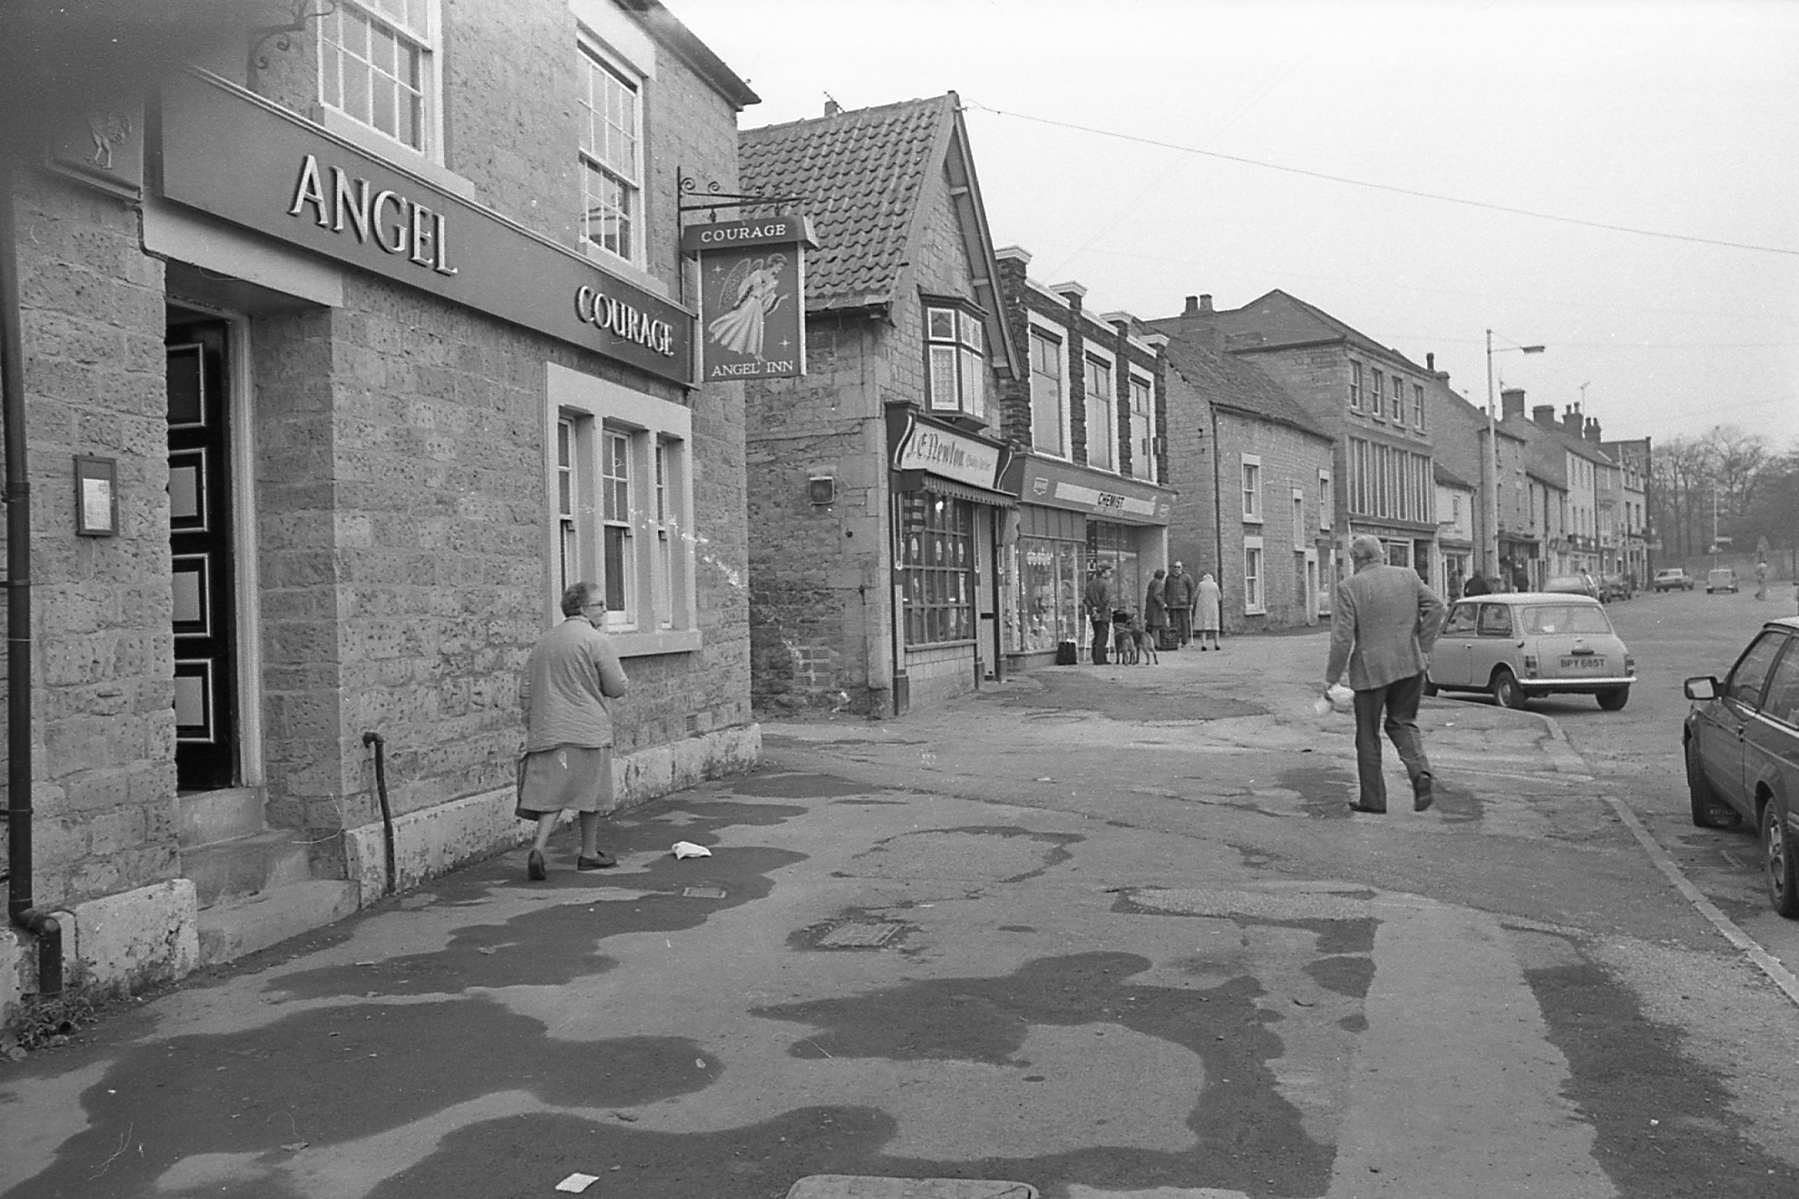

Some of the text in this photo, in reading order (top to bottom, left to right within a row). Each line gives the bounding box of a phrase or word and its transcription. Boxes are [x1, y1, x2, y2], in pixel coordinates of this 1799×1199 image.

[288, 154, 458, 276] ANGEL
[701, 223, 786, 243] COURAGE
[575, 285, 675, 357] COURAGE
[711, 360, 793, 377] ANGEL INN
[1097, 492, 1125, 509] CHEMIST
